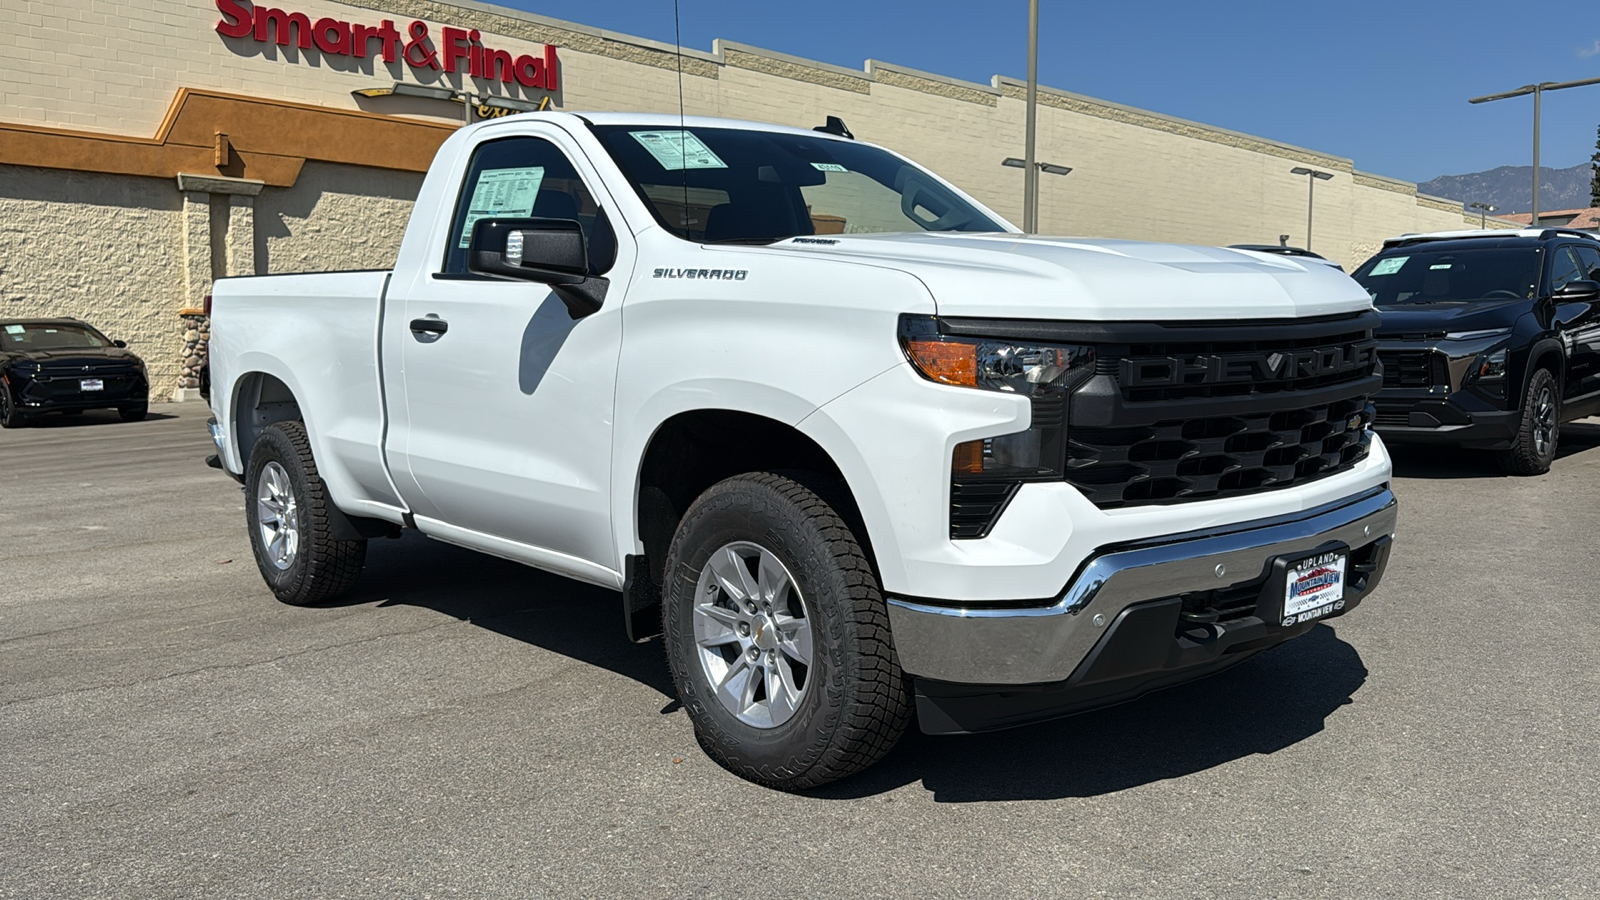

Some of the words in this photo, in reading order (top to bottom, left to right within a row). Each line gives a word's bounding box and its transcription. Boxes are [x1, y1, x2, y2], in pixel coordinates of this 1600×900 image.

[653, 268, 748, 280] SILVERADO
[1303, 553, 1334, 569] UPLAND
[1298, 608, 1322, 623] MOUNTAIN
[1322, 603, 1334, 614] VIEW
